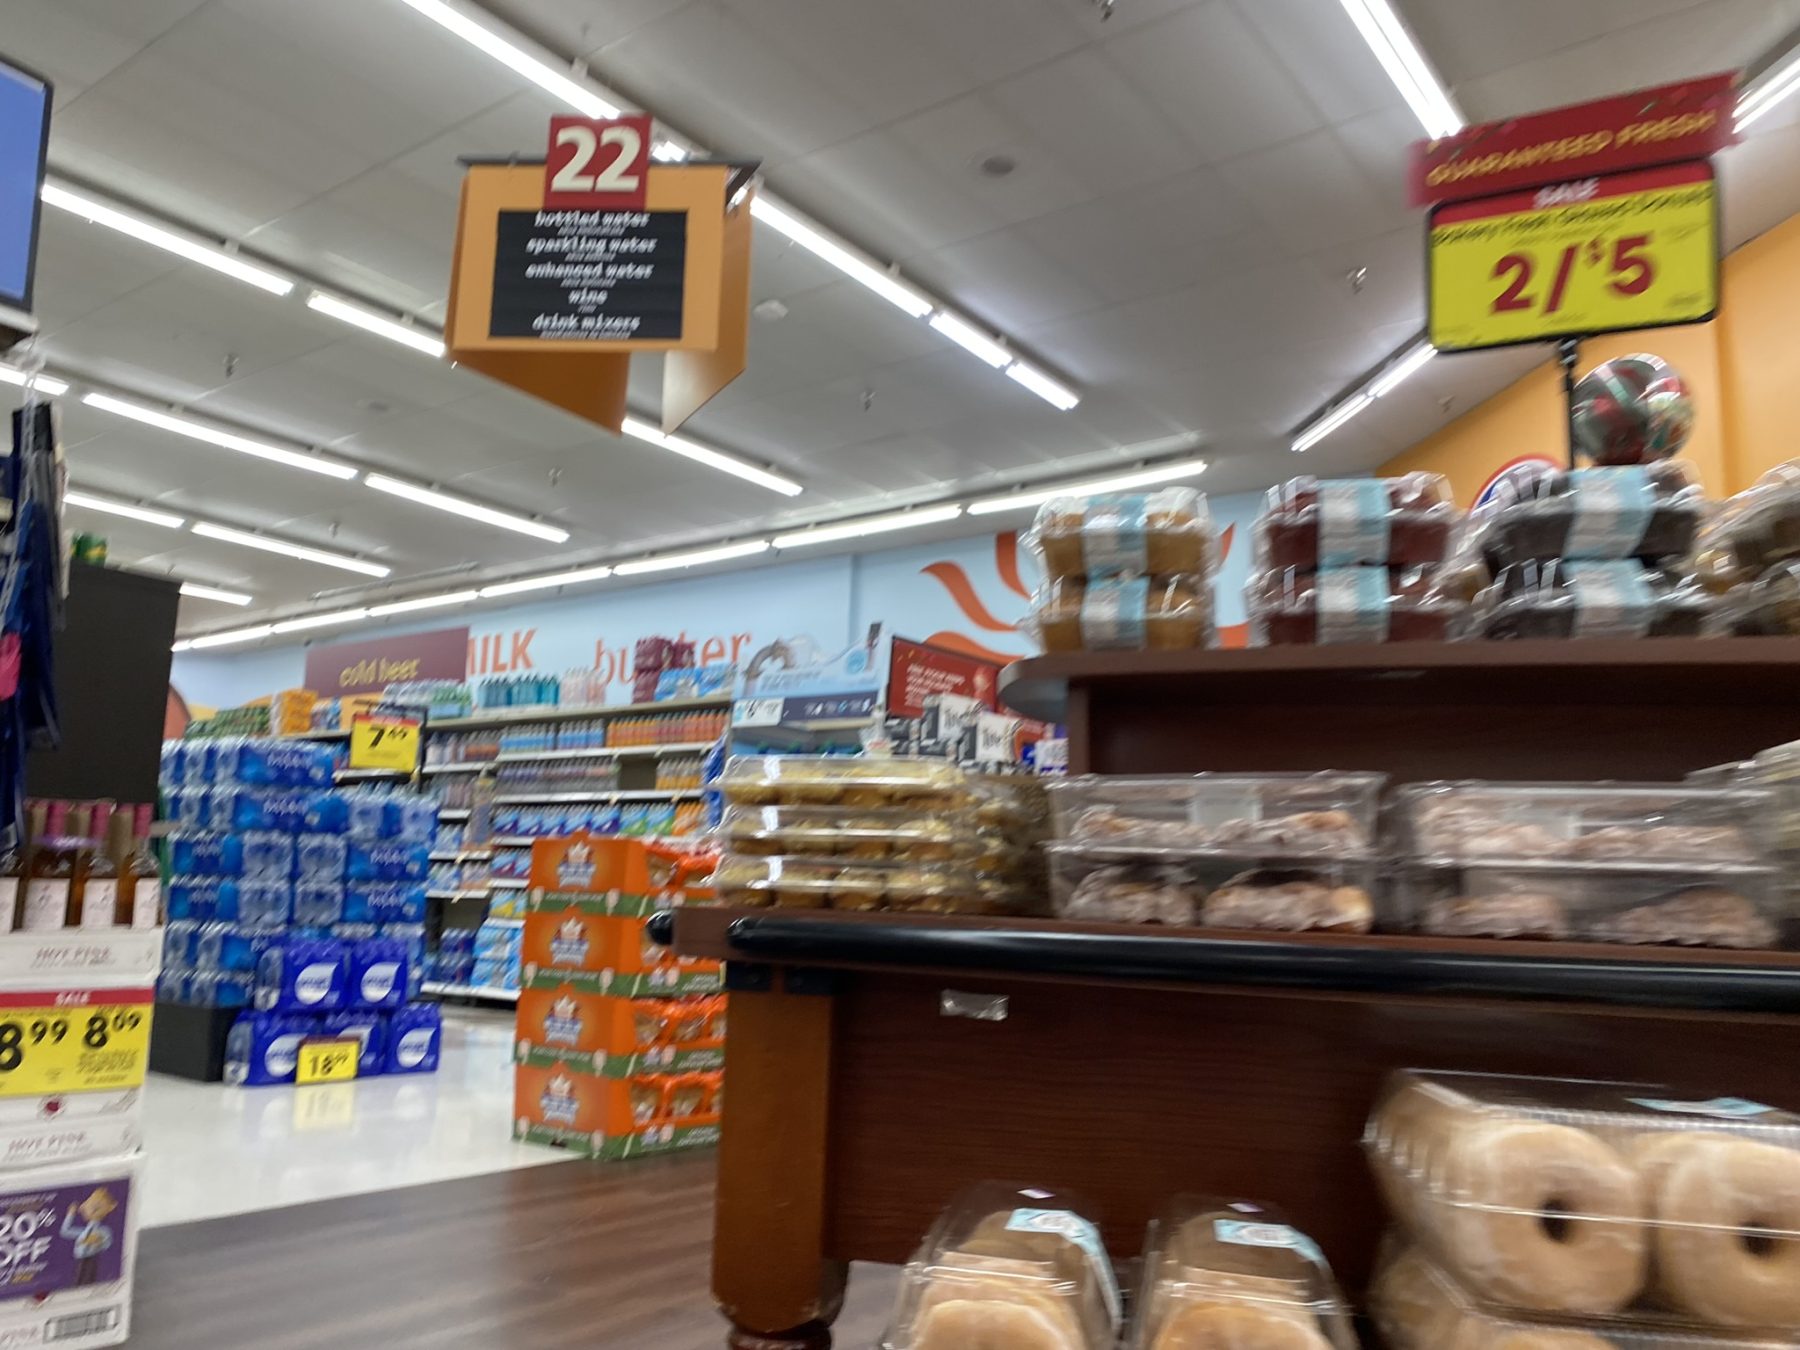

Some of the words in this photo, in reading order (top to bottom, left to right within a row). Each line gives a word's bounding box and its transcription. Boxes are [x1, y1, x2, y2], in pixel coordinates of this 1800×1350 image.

[551, 125, 641, 192] 22
[1426, 130, 1613, 187] GUARANTEED
[1614, 111, 1717, 150] FRESH
[1532, 177, 1600, 209] SALE
[534, 210, 600, 227] bottled
[601, 211, 651, 227] water
[525, 235, 606, 255] sparkling
[608, 237, 658, 253] water
[525, 261, 603, 278] enhanced
[605, 262, 654, 279] water
[567, 288, 608, 304] wine
[532, 313, 580, 330] drink
[580, 313, 641, 330] mixers
[338, 658, 378, 687] cold
[378, 656, 421, 682] beer
